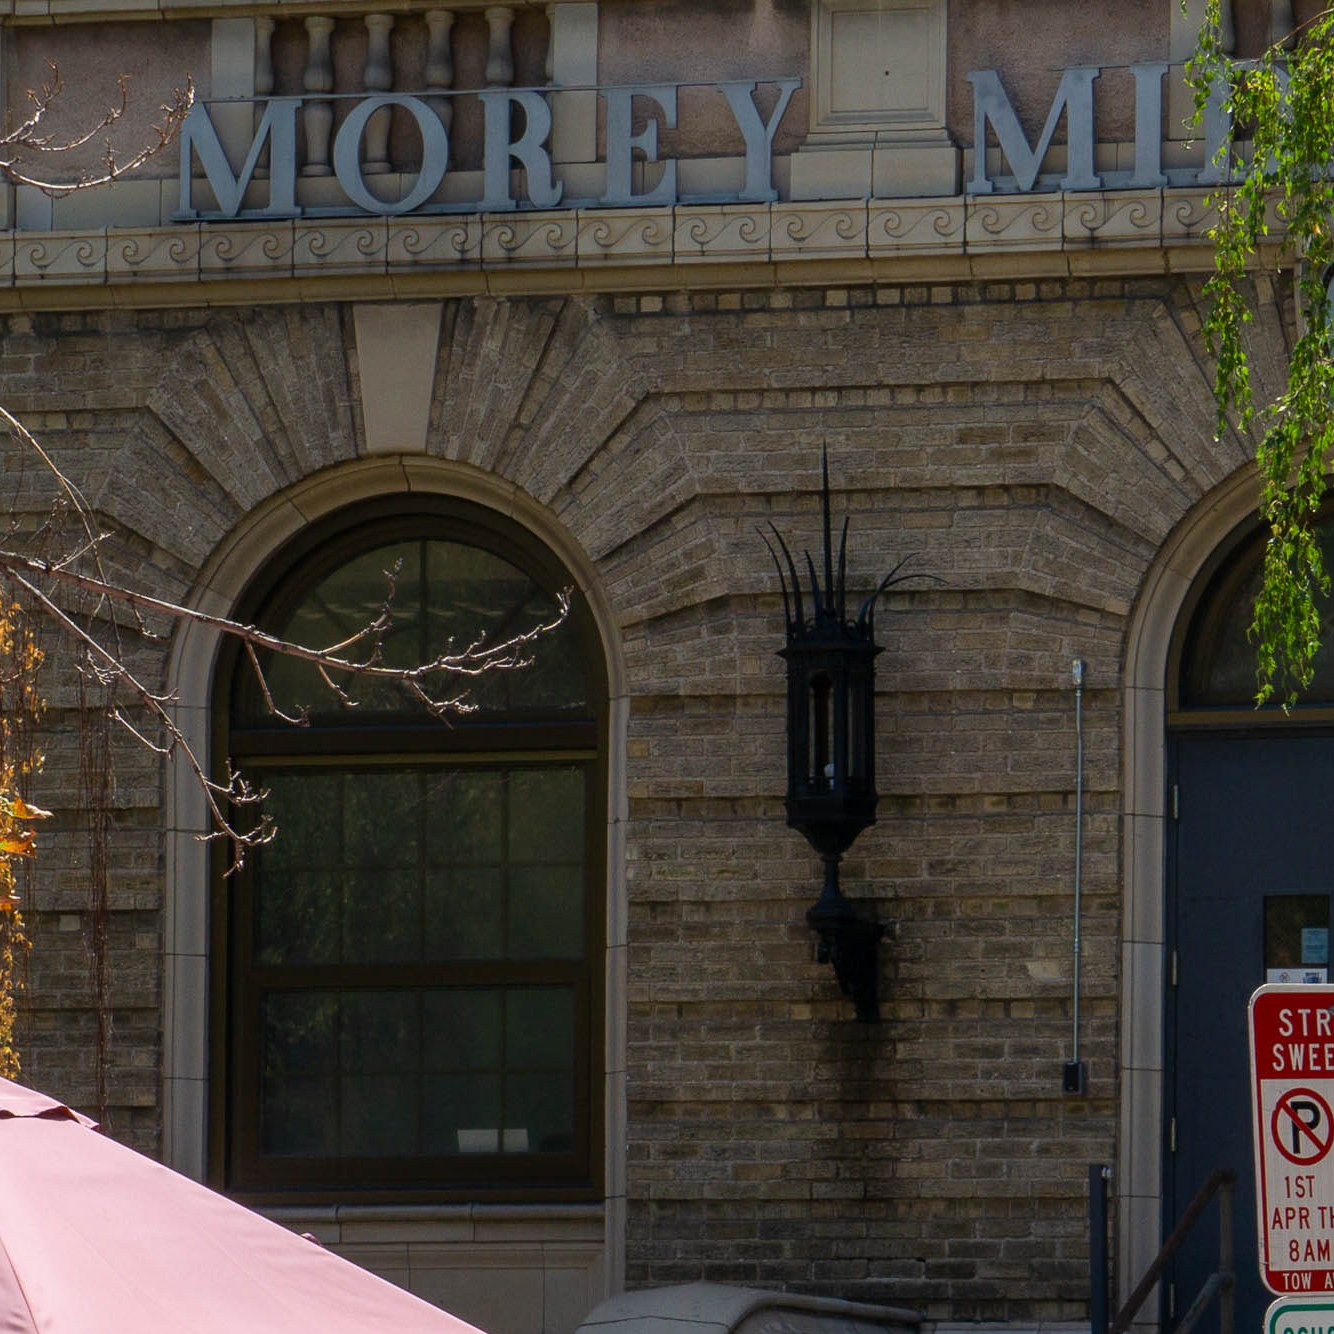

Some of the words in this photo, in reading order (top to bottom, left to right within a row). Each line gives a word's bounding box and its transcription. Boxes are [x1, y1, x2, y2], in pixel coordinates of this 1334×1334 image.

[172, 77, 800, 220] MOREY
[1284, 1175, 1315, 1199] 1ST
[1271, 1206, 1310, 1230] APR
[1289, 1239, 1331, 1263] 8AM
[1283, 1273, 1312, 1290] TOW
